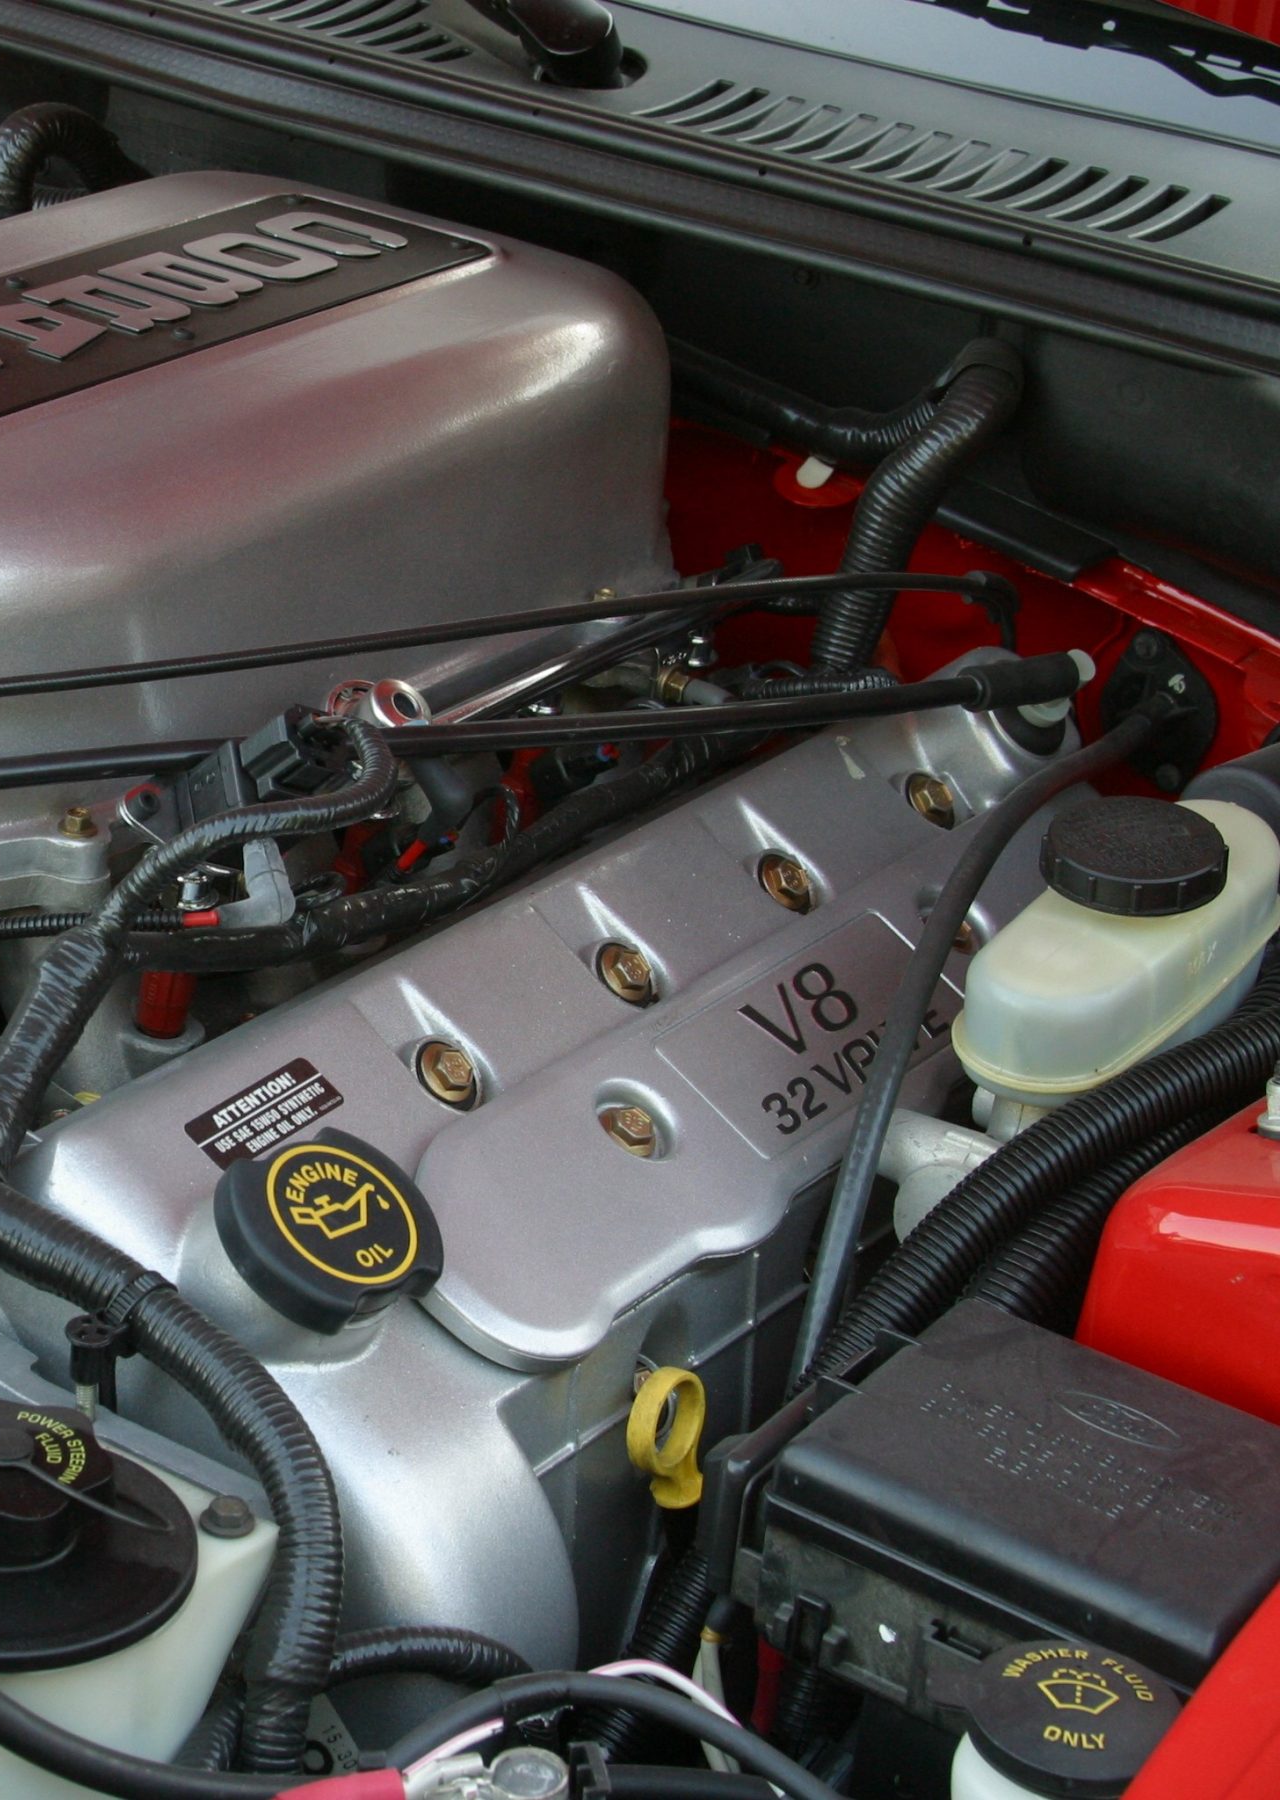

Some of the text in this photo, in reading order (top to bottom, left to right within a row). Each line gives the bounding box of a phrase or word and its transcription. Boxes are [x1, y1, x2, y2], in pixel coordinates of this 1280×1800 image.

[737, 963, 858, 1054] V8
[761, 1009, 950, 1135] 32 VAE
[212, 1072, 297, 1129] ATTENTION!
[214, 1135, 236, 1153] USE
[232, 1125, 254, 1142] SAE
[250, 1109, 281, 1131] 15W50
[277, 1082, 325, 1115] SYNTHETIC
[245, 1106, 318, 1153] ENGINE OIL ONLY.
[285, 1162, 358, 1204] ENGINE
[355, 1243, 393, 1268] OIL
[17, 1411, 86, 1485] POWER STEERIN
[35, 1432, 62, 1464] FLUID
[1002, 1648, 1155, 1702] WASHER FLUID
[1043, 1725, 1105, 1749] ONLY
